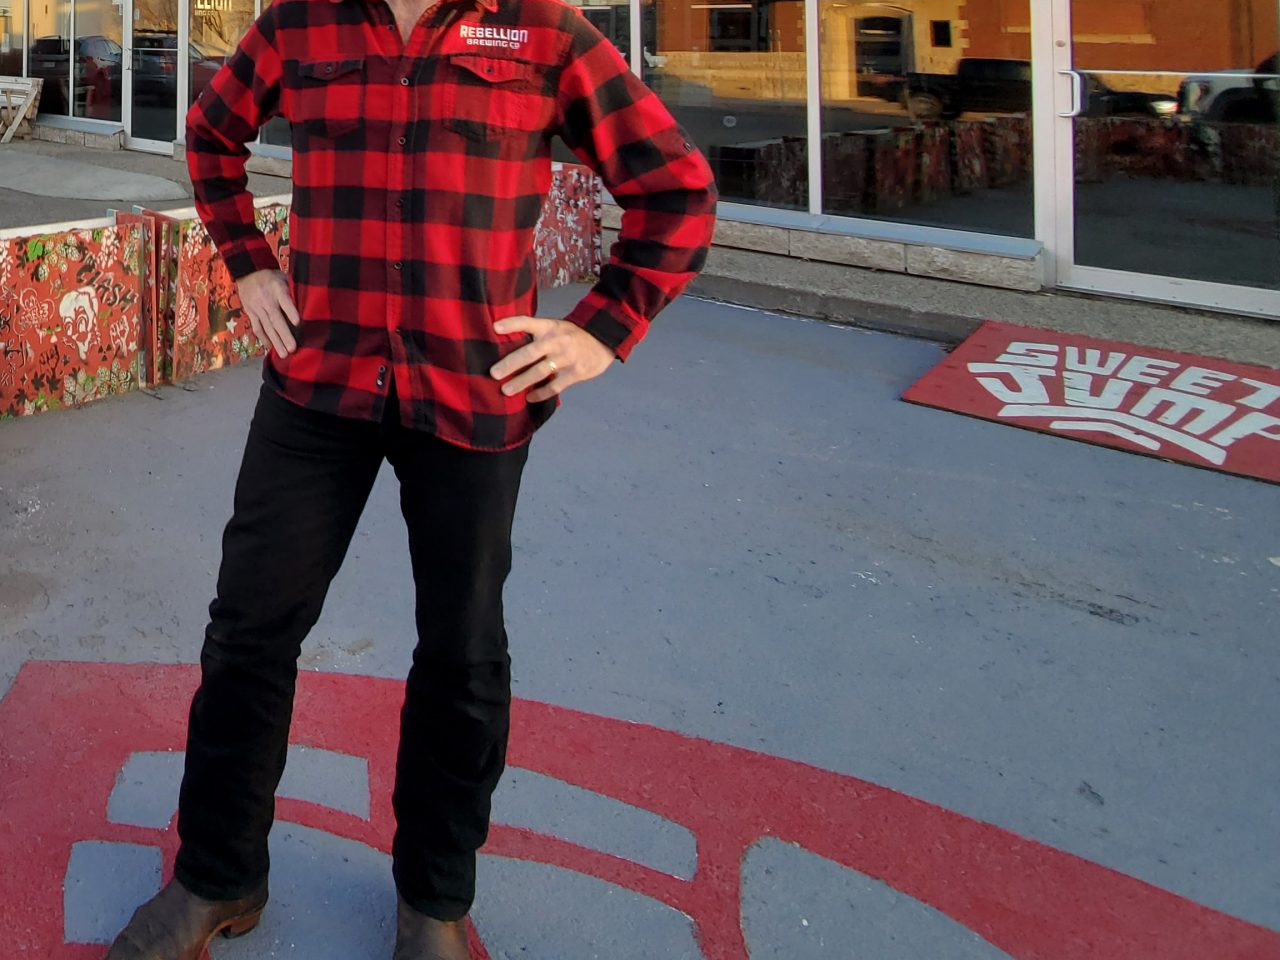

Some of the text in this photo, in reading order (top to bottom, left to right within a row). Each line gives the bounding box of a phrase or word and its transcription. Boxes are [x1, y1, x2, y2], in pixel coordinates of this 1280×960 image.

[460, 24, 528, 44] REBELLION
[466, 38, 508, 48] BREWING
[995, 341, 1280, 410] SWEET
